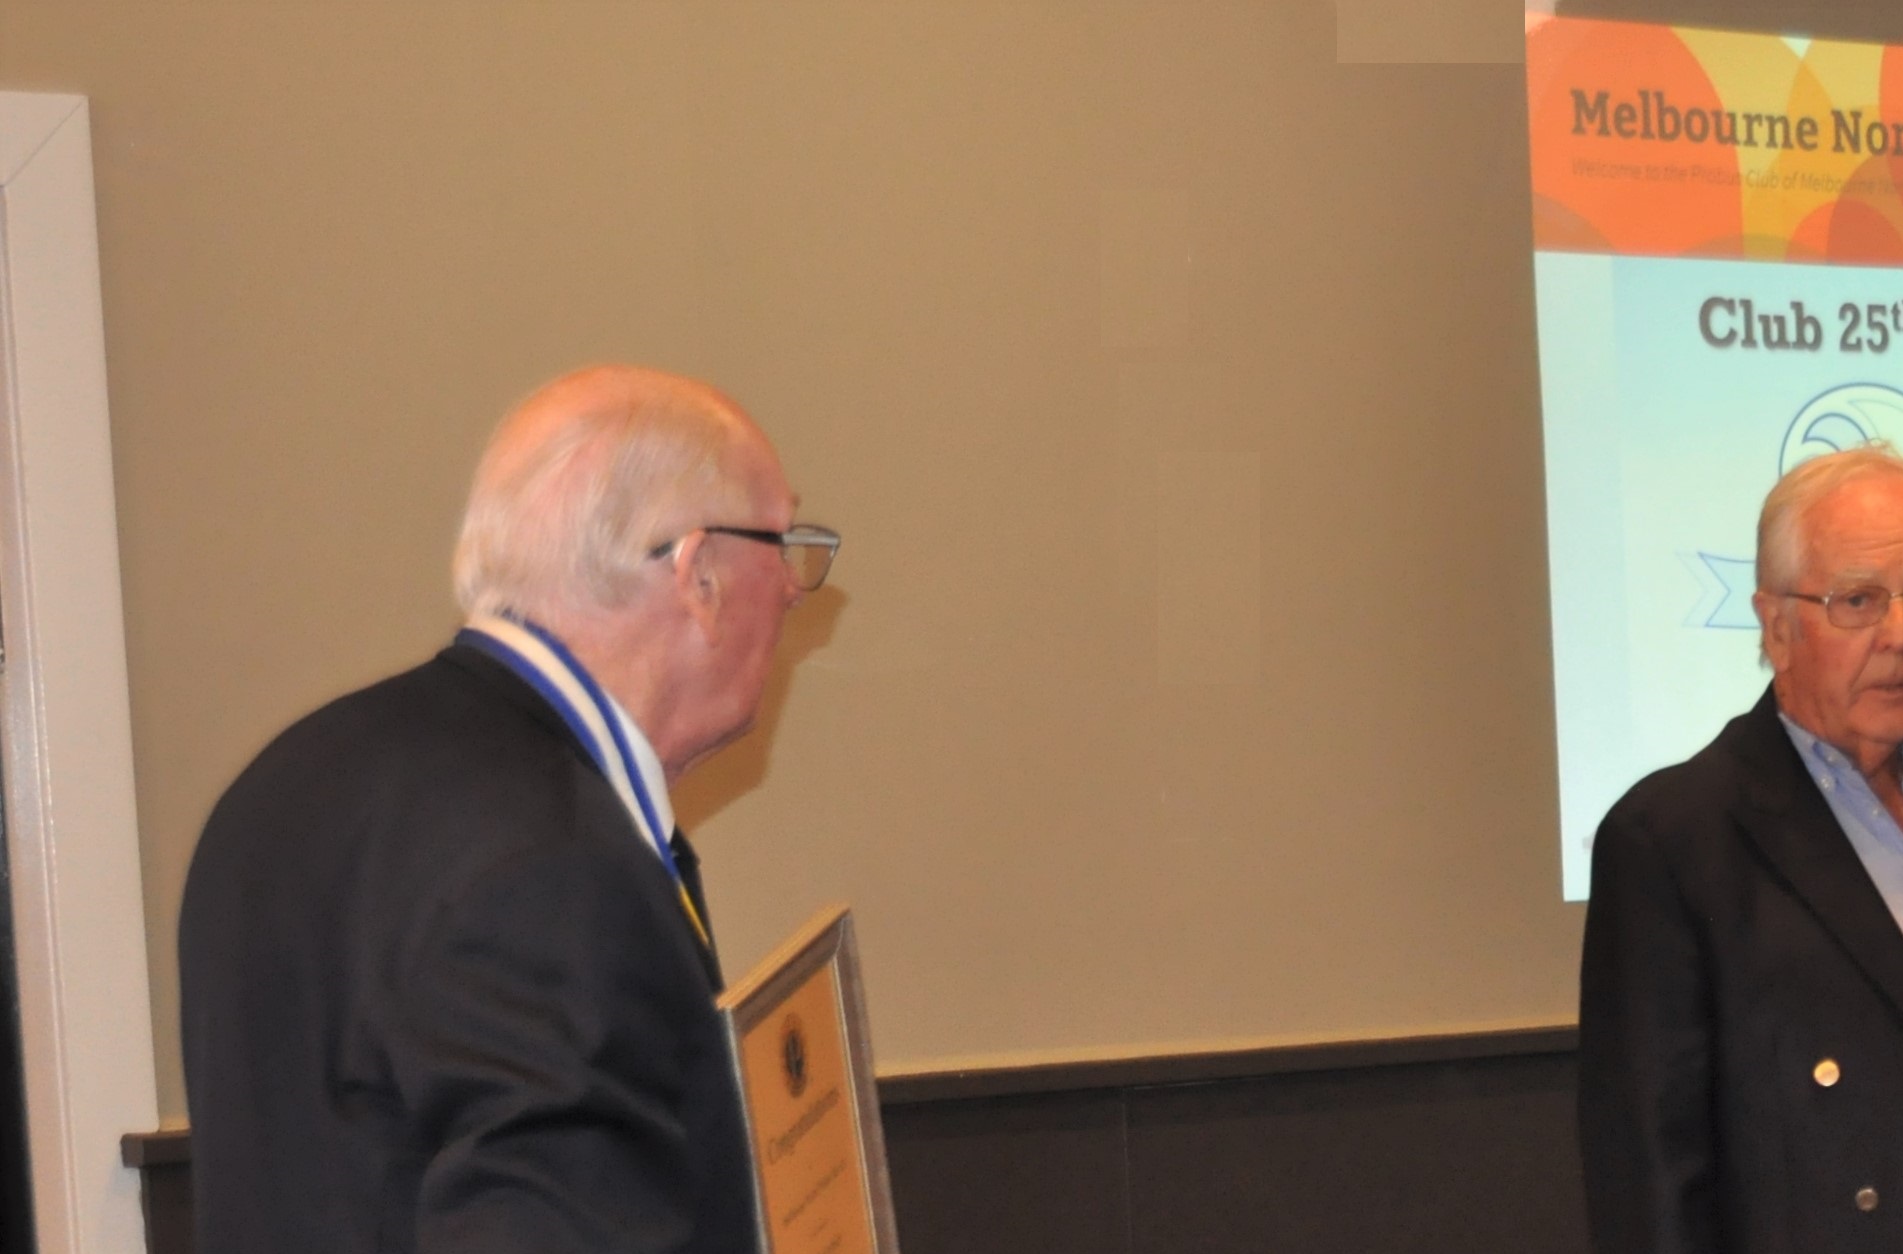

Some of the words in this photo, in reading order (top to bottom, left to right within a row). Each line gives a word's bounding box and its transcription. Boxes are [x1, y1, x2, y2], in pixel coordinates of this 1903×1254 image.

[1570, 88, 1818, 151] Melbourne
[1745, 168, 1778, 189] Club
[1782, 169, 1799, 190] of
[1800, 172, 1875, 195] Melbourne
[1699, 297, 1823, 350] Club
